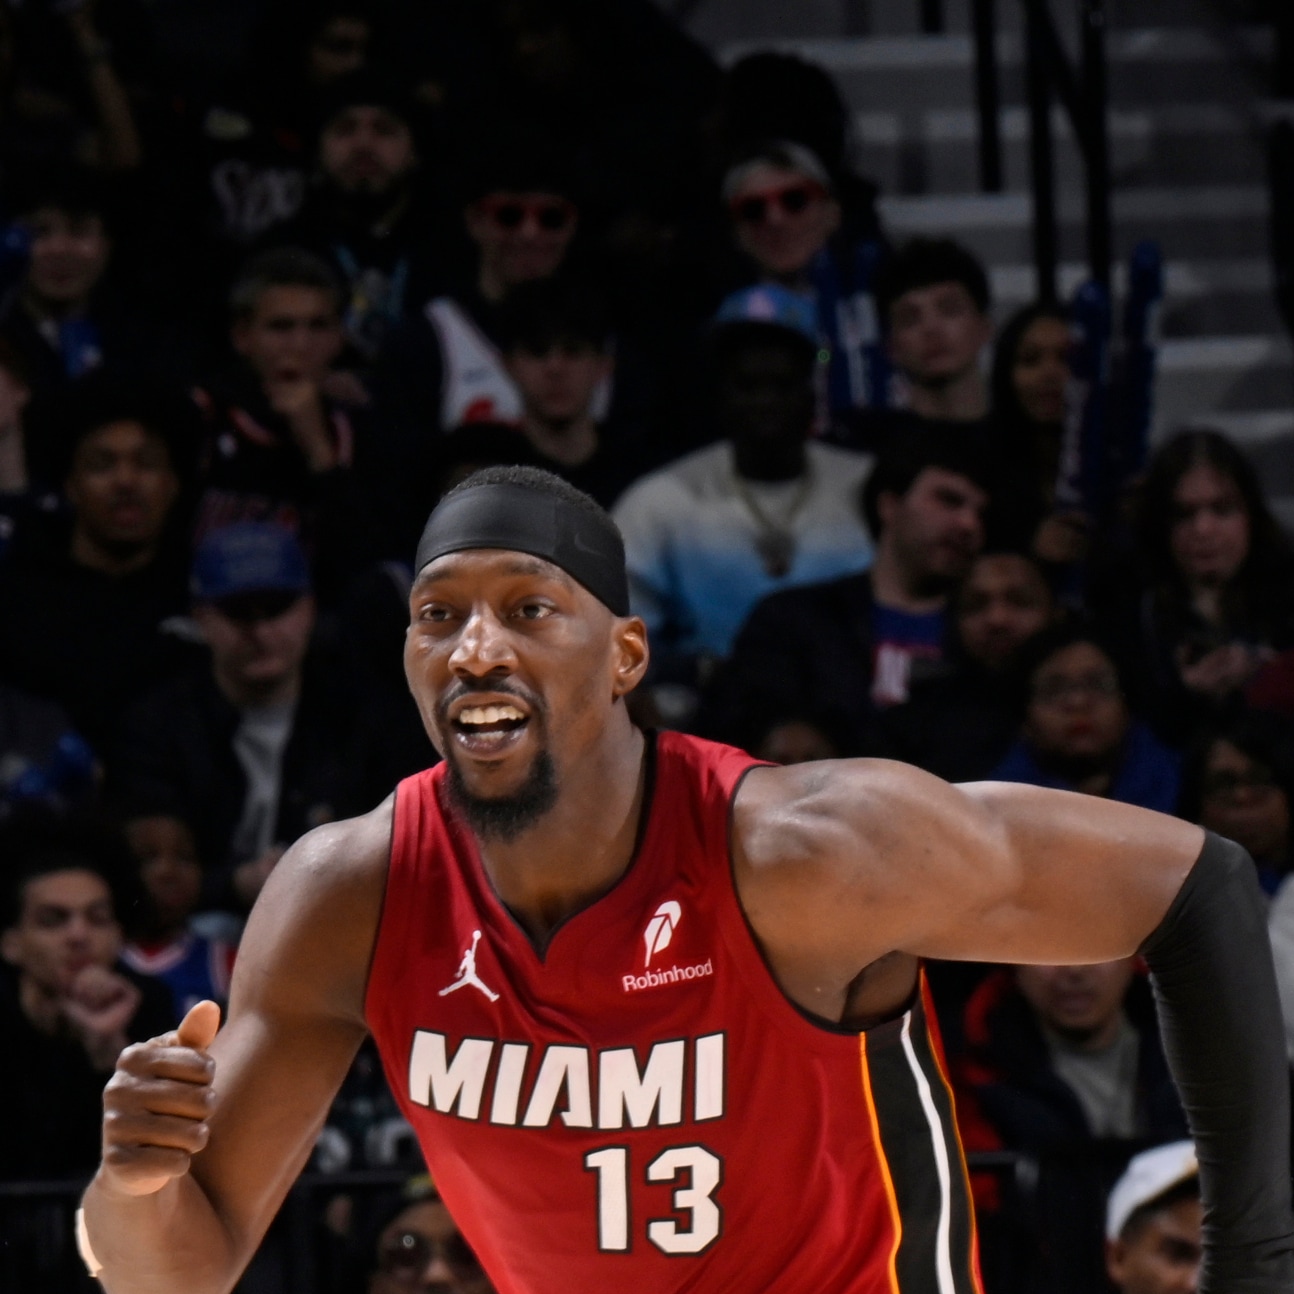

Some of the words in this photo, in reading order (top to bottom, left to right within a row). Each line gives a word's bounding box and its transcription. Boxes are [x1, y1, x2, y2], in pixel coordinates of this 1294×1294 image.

[622, 957, 714, 992] Robinhood
[406, 1028, 727, 1131] MIAMI
[583, 1141, 726, 1258] 13
